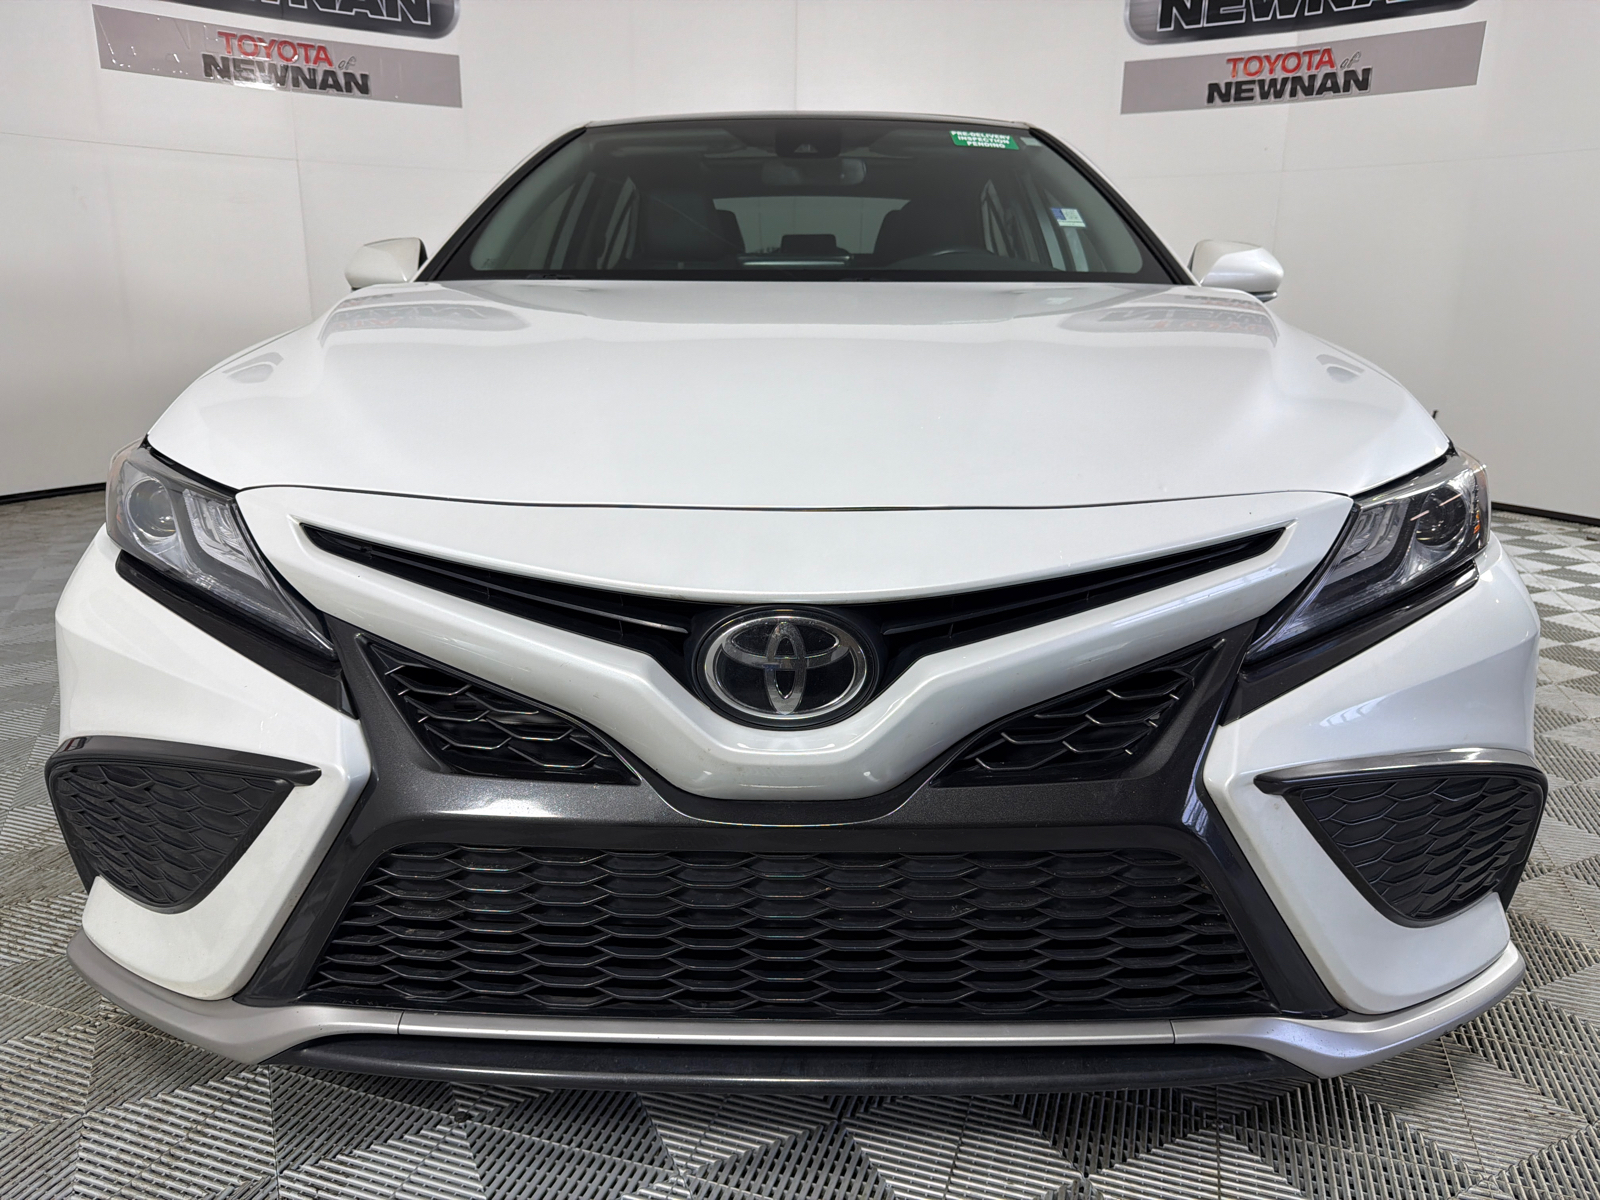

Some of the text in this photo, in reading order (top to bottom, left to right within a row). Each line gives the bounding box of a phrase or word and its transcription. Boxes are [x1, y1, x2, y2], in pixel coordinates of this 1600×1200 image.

[217, 31, 357, 71] TOYOTA of
[1226, 48, 1362, 78] TOYOTA of
[201, 53, 370, 95] NEWNAN
[1206, 67, 1373, 104] NEWNAN
[950, 130, 1010, 140] PRE-DELIVERY
[957, 135, 1010, 145] INSPECTION
[966, 141, 1006, 149] PENDING
